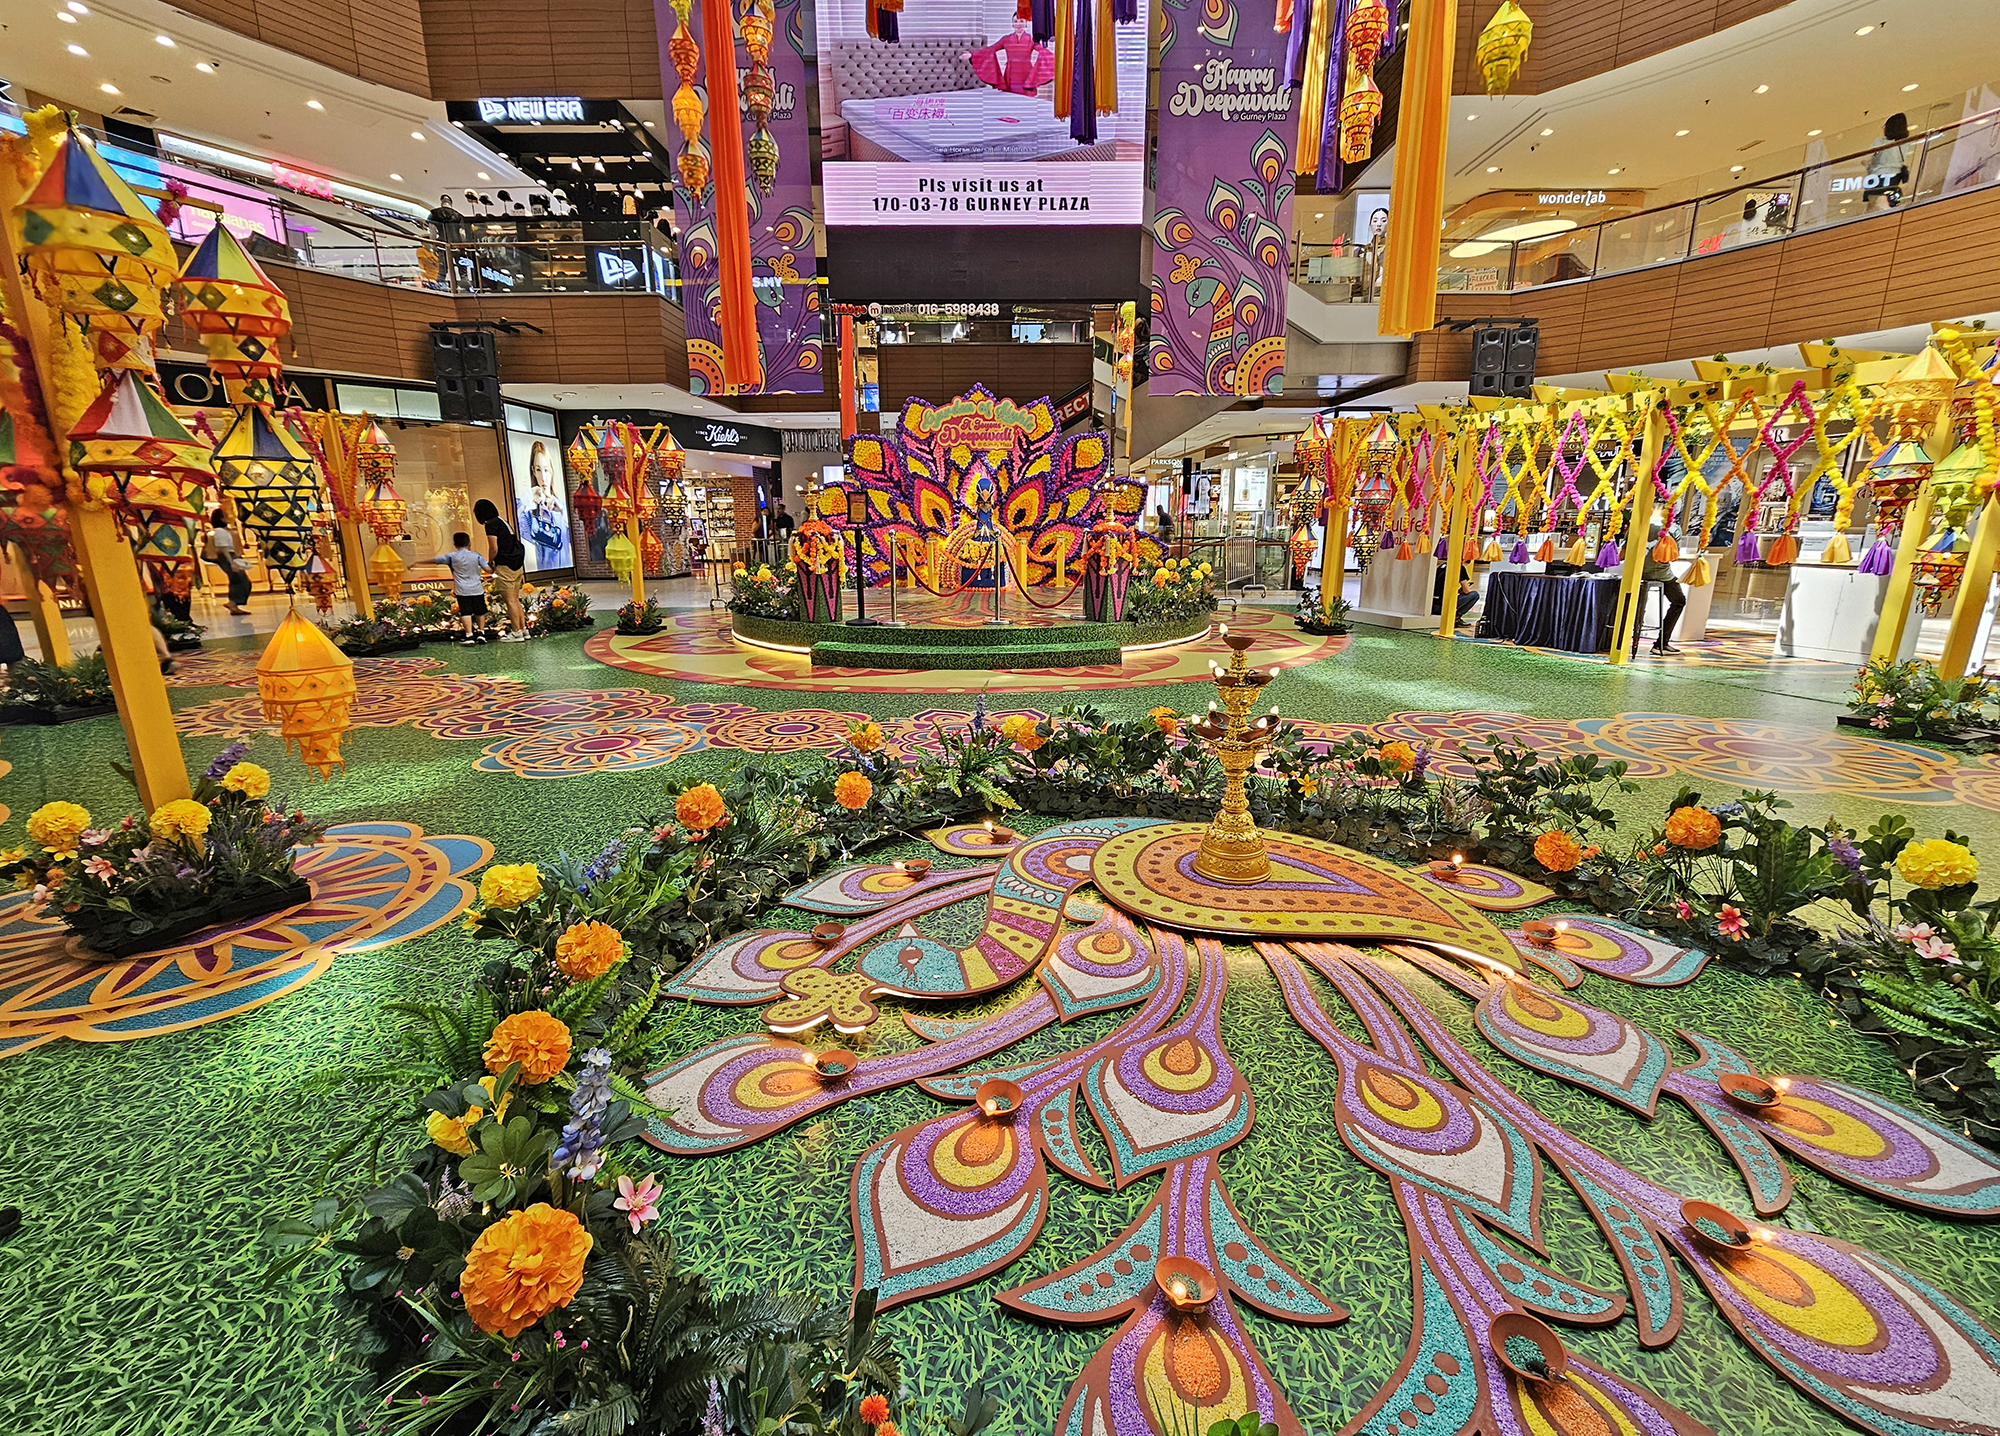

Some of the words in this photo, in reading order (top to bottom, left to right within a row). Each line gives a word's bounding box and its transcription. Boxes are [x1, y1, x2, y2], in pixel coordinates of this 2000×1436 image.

[1203, 58, 1275, 93] Happy
[1169, 81, 1292, 120] Deepavali
[507, 97, 546, 120] NEW
[544, 96, 584, 120] ERA
[772, 111, 792, 120] Plaza
[1240, 113, 1266, 122] Gurney
[1267, 112, 1286, 121] Plaza
[919, 178, 946, 192] Pls
[951, 178, 992, 192] visit
[999, 180, 1019, 192] us
[1025, 178, 1043, 192] at
[872, 197, 959, 211] 170-03-78
[966, 197, 1031, 211] GURNEY
[1038, 197, 1090, 211] PLAZA
[1538, 191, 1606, 206] wonderlab
[918, 303, 1000, 316] 016-5988438
[704, 423, 740, 443] Kiehl's
[939, 425, 1015, 447] Deepavali
[410, 582, 446, 591] BONIA
